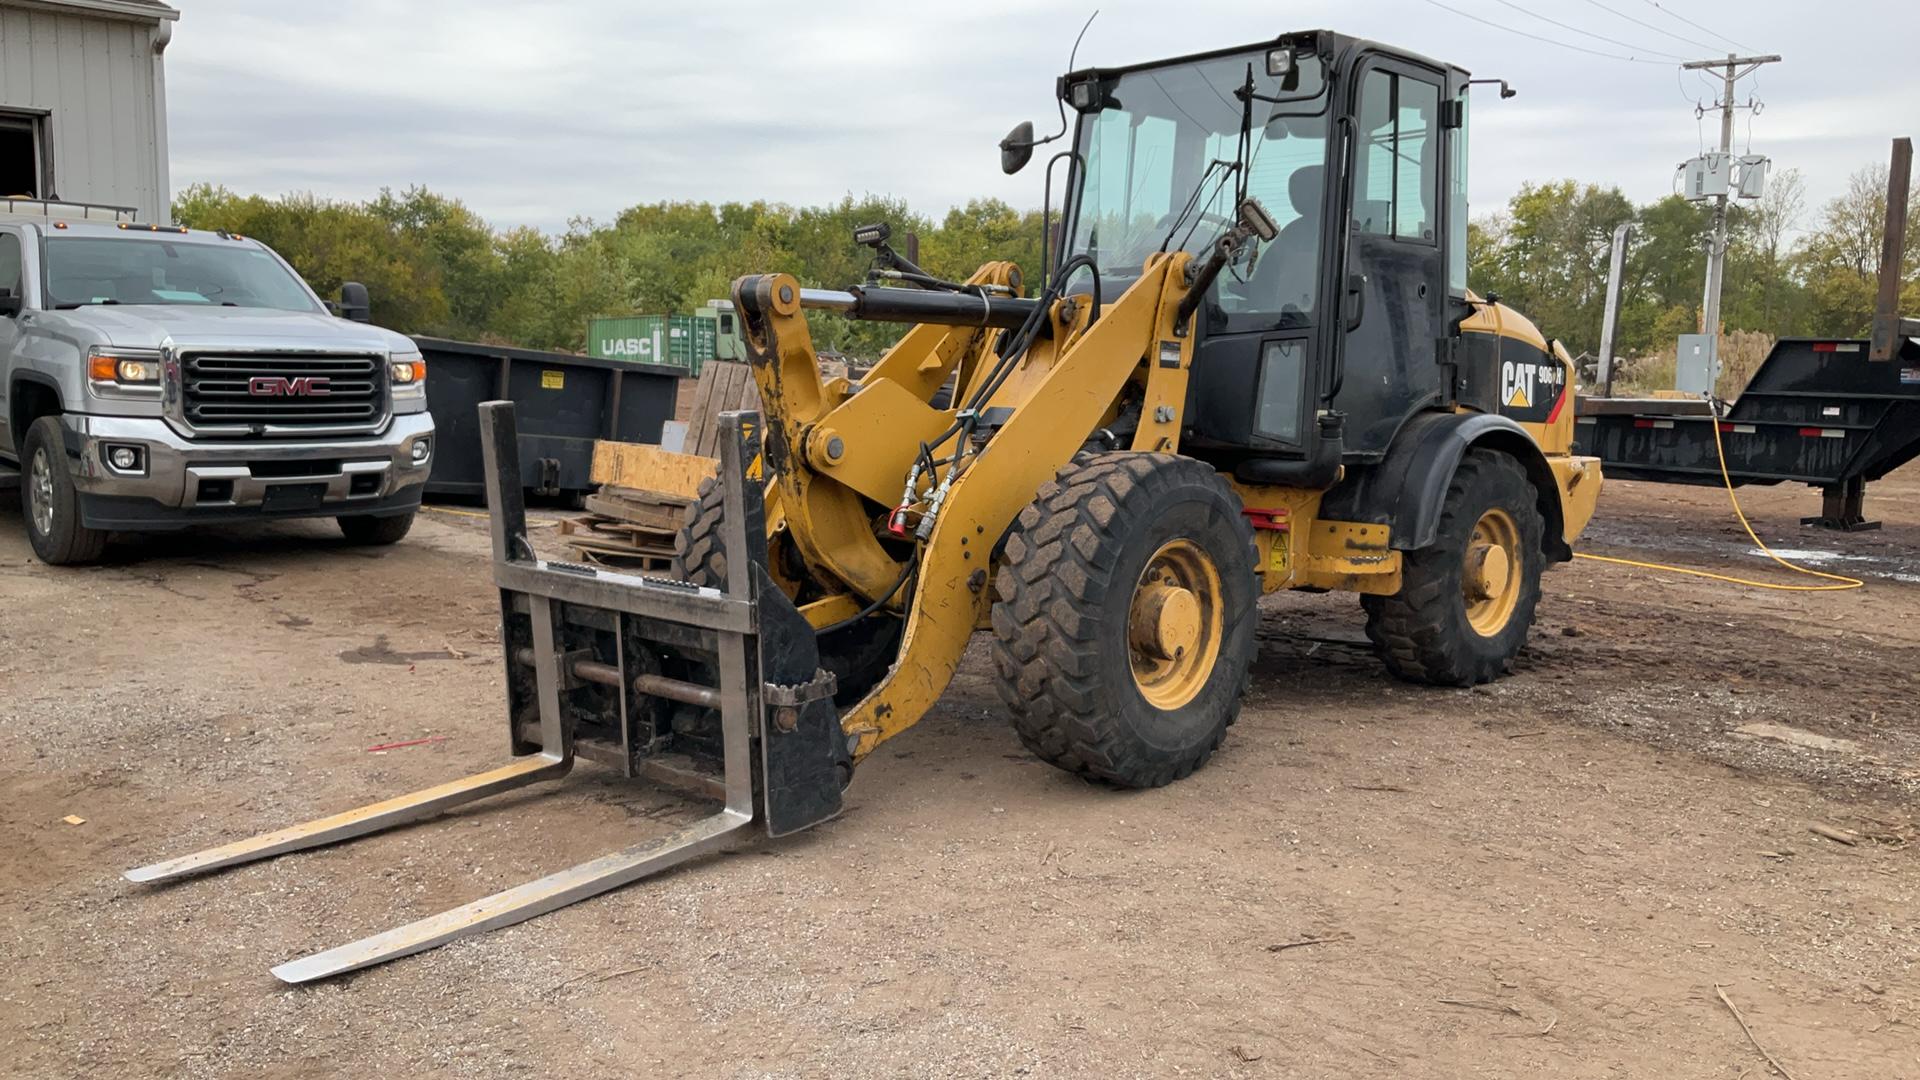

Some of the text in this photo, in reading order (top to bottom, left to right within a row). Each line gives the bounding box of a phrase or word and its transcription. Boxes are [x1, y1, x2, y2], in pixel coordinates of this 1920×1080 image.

[602, 338, 651, 355] UASC
[249, 376, 331, 396] GMC
[1502, 361, 1536, 407] CAT
